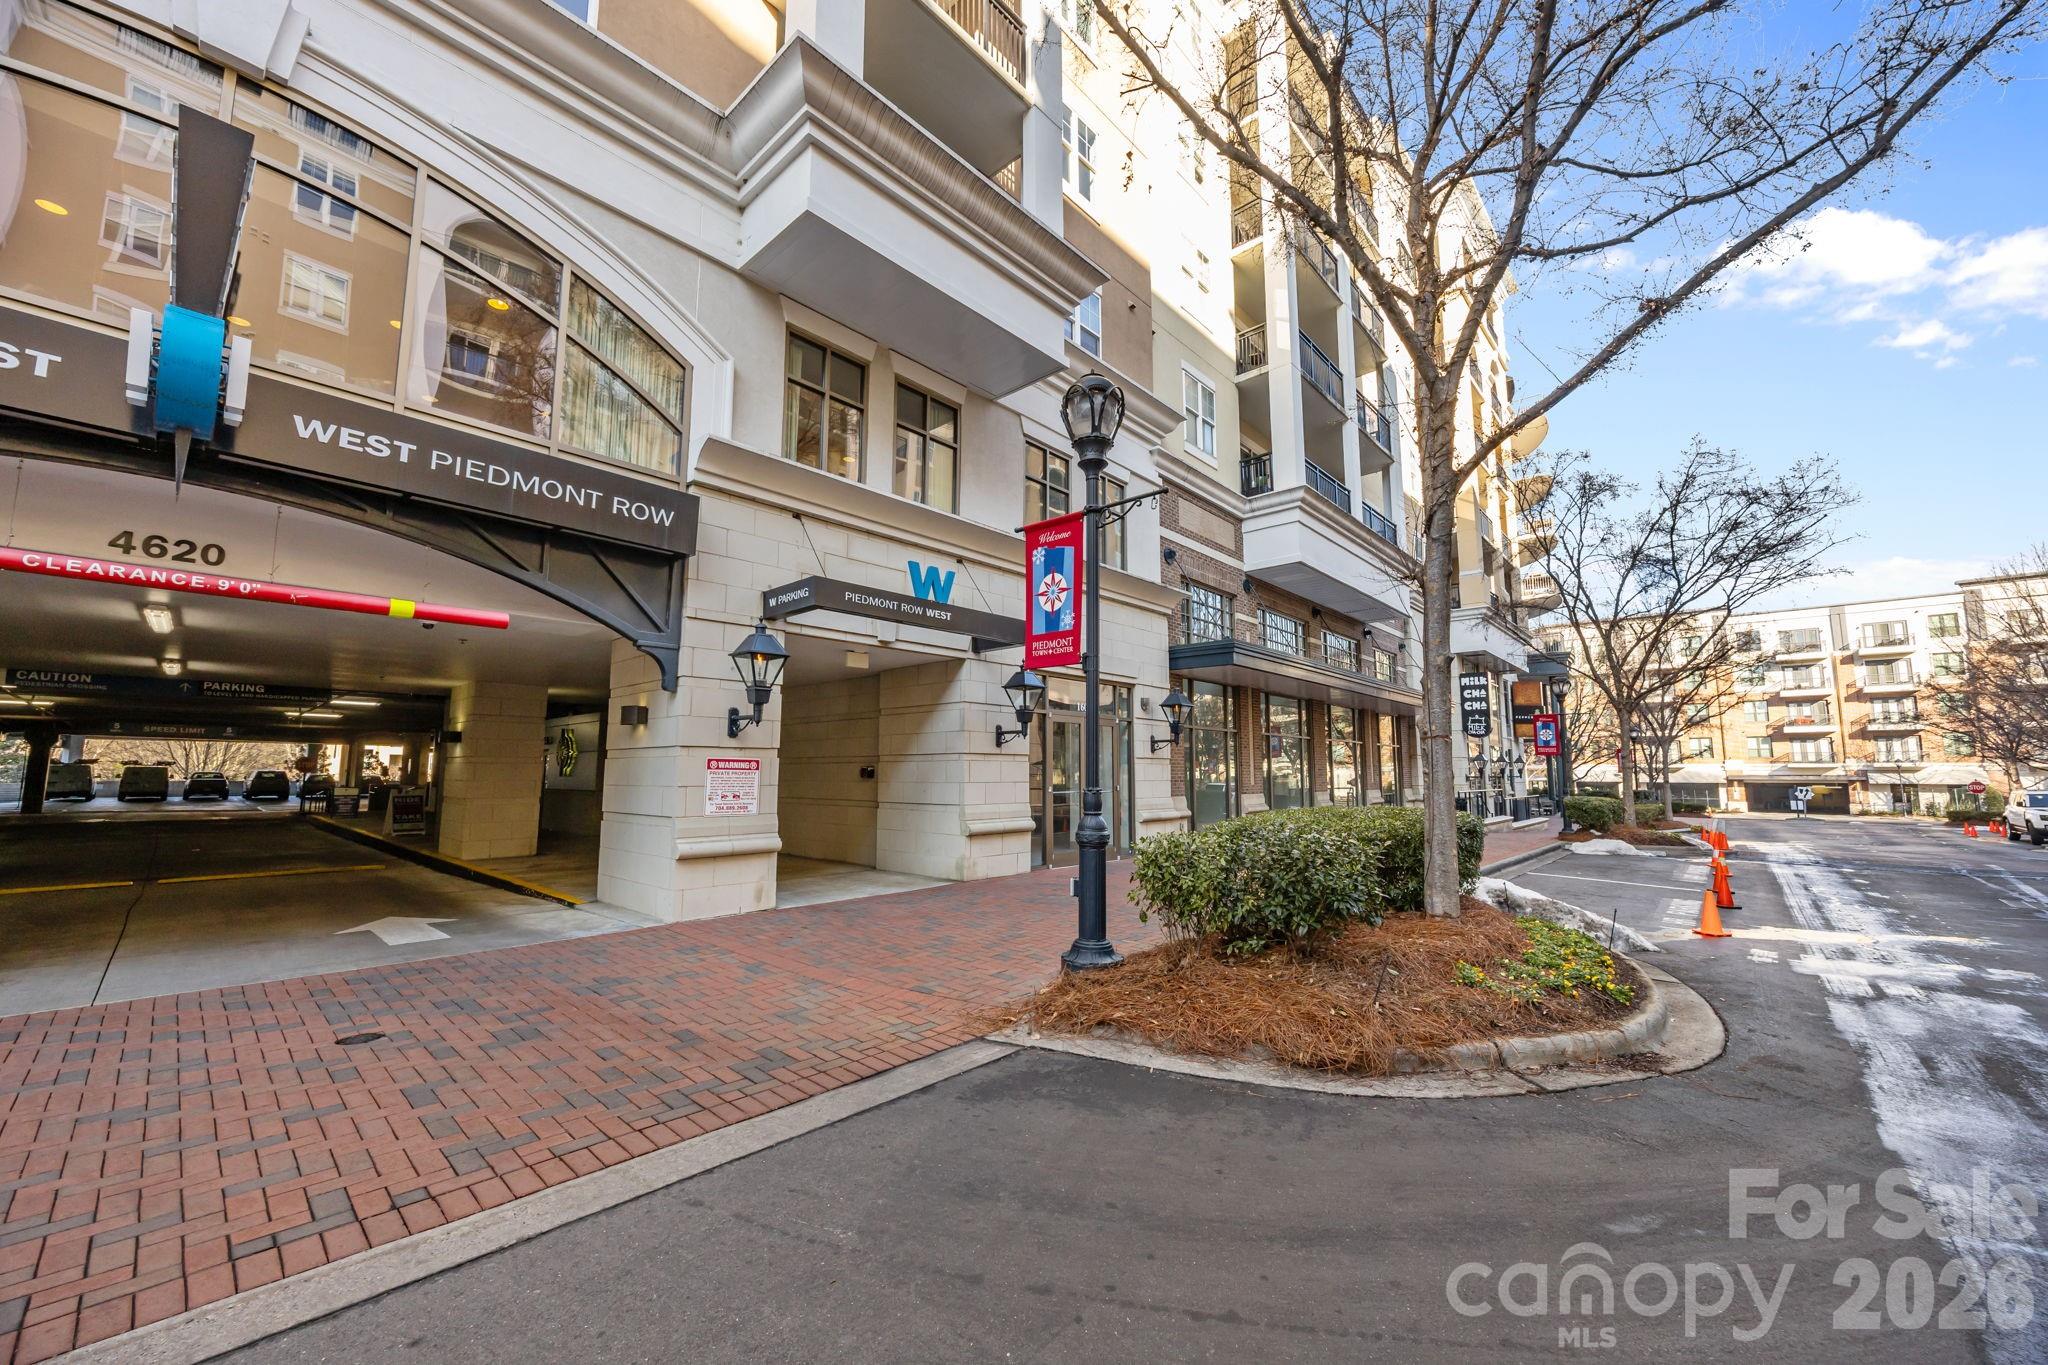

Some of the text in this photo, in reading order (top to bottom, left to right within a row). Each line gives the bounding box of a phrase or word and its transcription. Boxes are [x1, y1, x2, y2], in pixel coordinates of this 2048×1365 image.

[293, 414, 675, 527] WEST PIEDMONT ROW
[1039, 531, 1071, 544] Welcome
[107, 530, 226, 566] 4620
[22, 554, 205, 587] CLEARANCE
[907, 560, 956, 604] W
[769, 587, 809, 607] W PARKING
[845, 591, 952, 621] PIEDMONT ROW WEST
[1032, 637, 1074, 650] PIEDMONT
[1032, 646, 1074, 657] TOWN CENTER
[16, 670, 92, 683] CAUTION
[203, 681, 265, 693] PARKING
